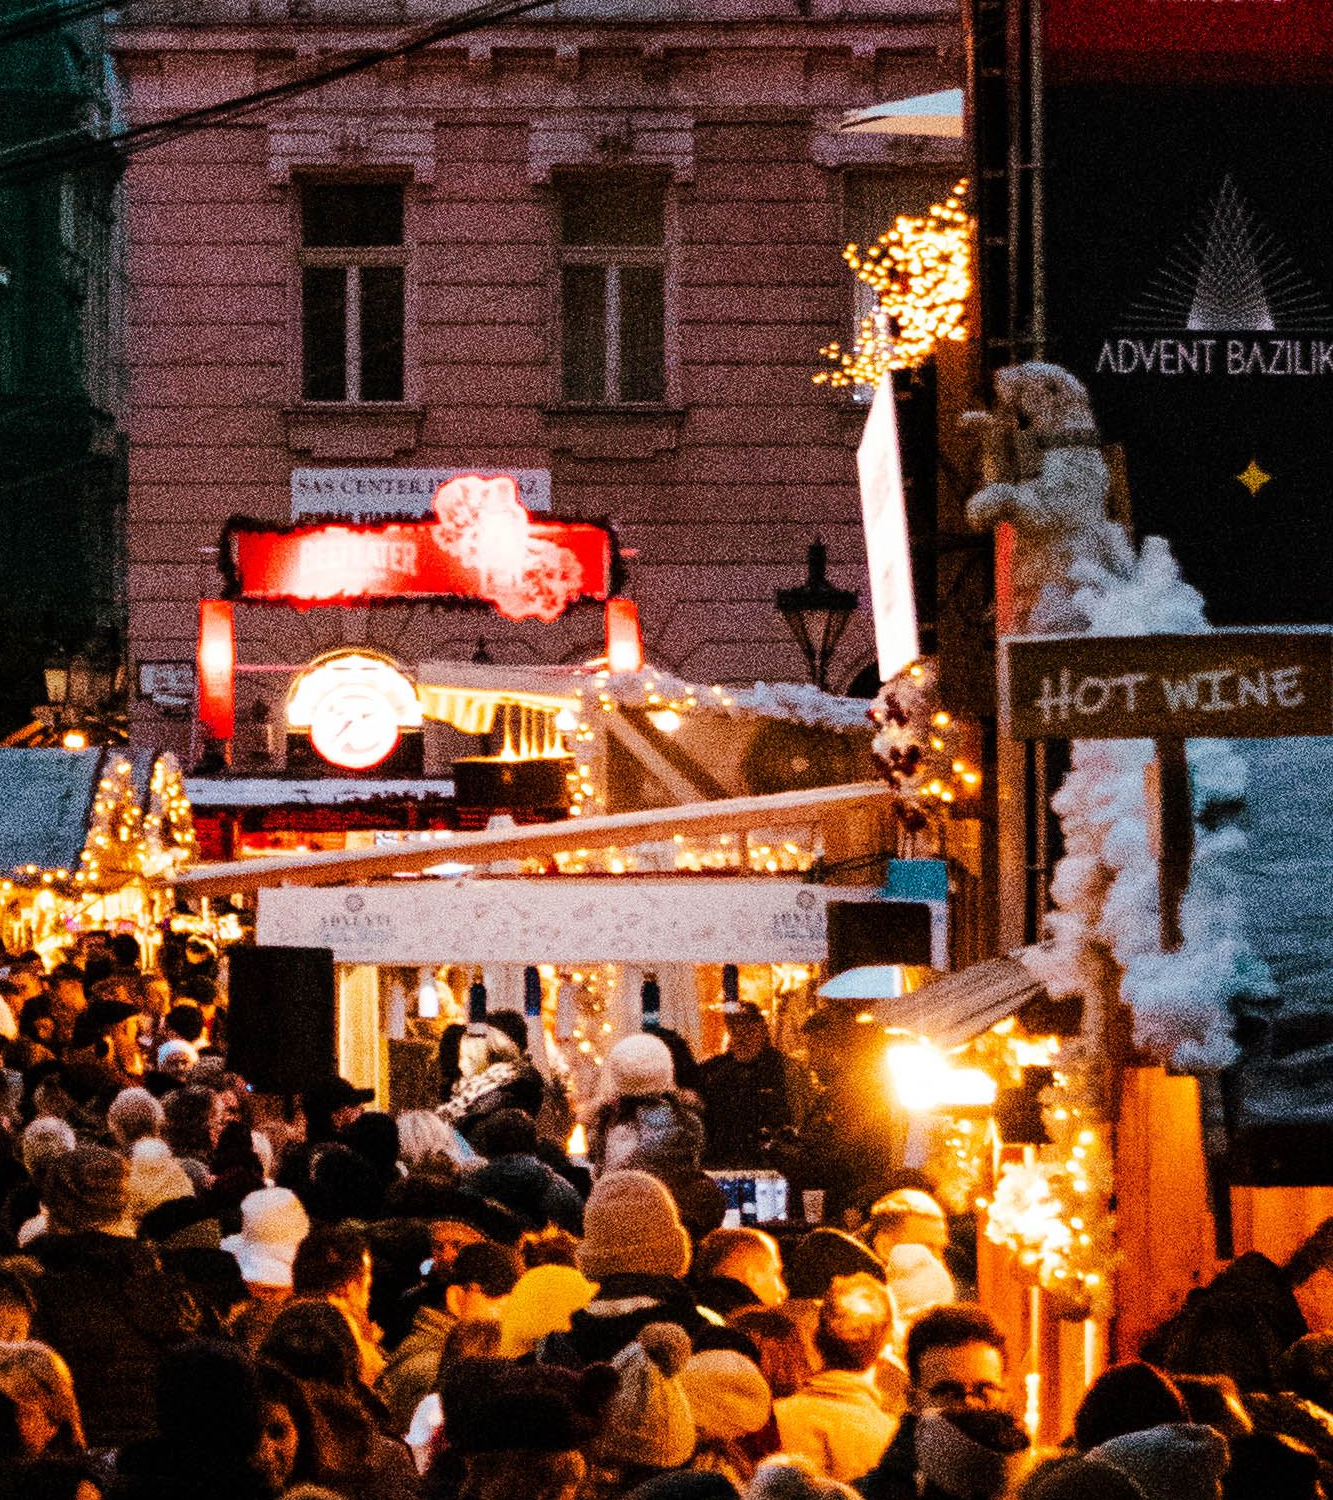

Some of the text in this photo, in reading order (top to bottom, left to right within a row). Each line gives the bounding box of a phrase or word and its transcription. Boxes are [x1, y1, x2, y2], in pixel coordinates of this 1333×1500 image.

[1096, 339, 1216, 375] ADVENT
[339, 477, 424, 495] CENTER
[1038, 665, 1304, 719] HOT WINE
